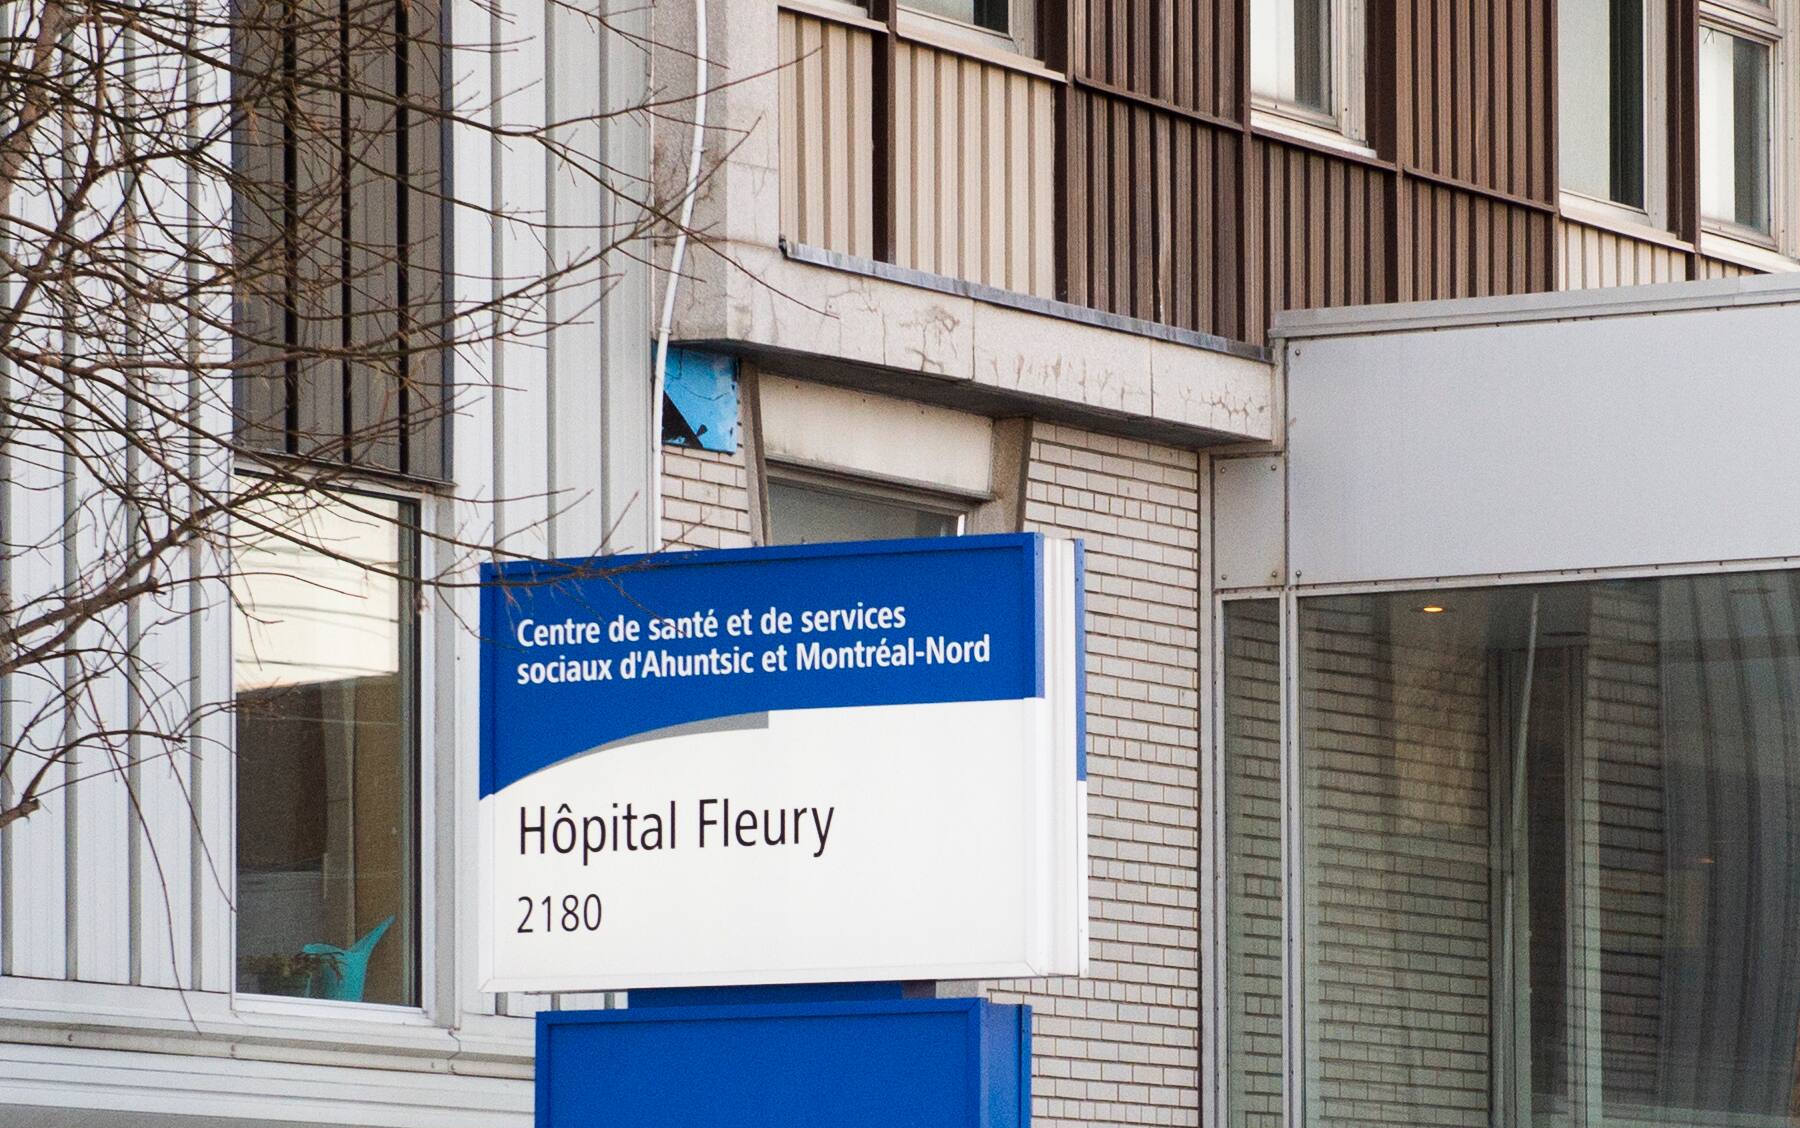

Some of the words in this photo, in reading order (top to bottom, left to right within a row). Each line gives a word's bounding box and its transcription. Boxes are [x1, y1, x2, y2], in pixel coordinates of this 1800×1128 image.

[517, 618, 601, 647] Centre
[608, 614, 641, 643] de
[648, 608, 719, 641] santé
[726, 608, 753, 637] et
[760, 606, 793, 635] de
[801, 601, 906, 633] services
[517, 659, 613, 685] sociaux
[619, 646, 754, 680] d'Ahuntsic
[761, 644, 788, 673] et
[796, 633, 991, 671] Montréal-Nord
[520, 800, 677, 866] Hôpital
[699, 798, 835, 858] Fleury
[517, 893, 603, 933] 2180
